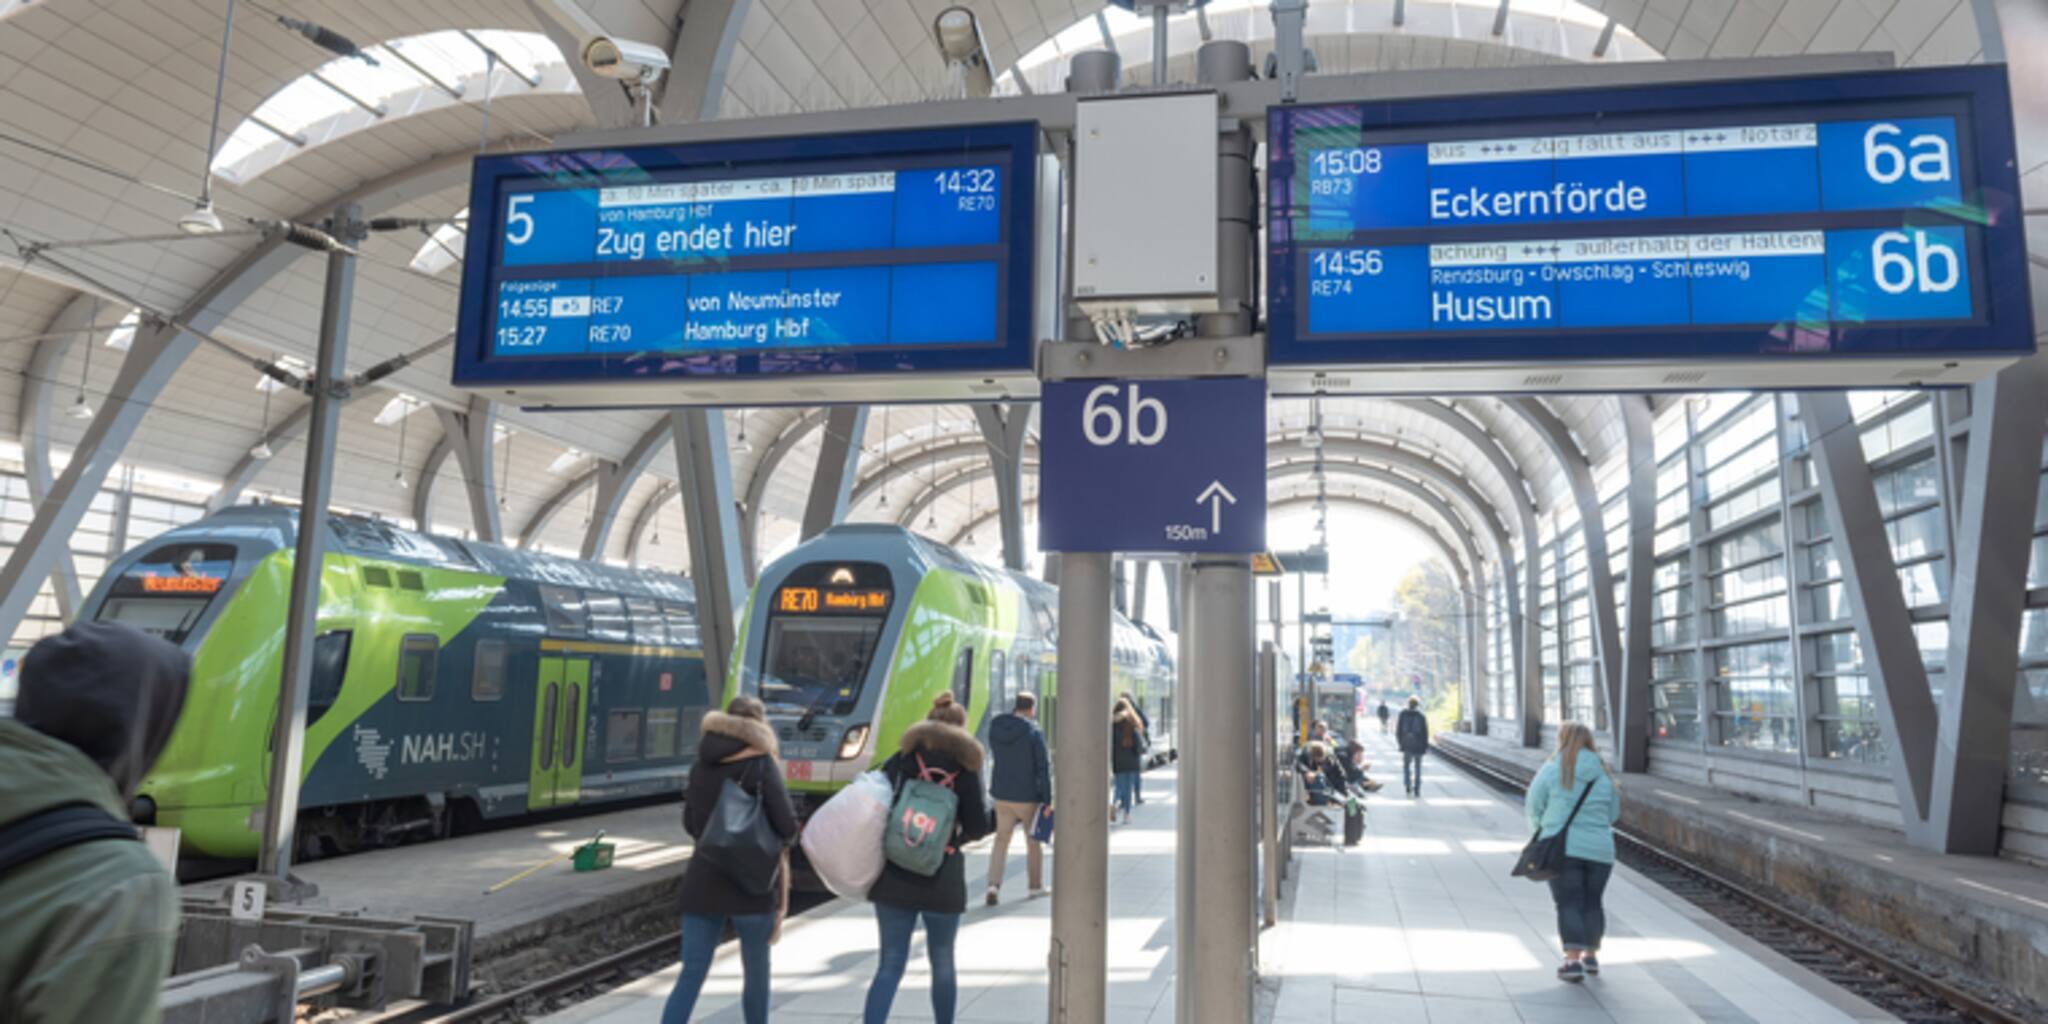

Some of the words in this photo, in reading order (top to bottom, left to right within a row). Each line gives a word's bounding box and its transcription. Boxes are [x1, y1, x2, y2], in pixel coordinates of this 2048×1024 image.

[1530, 138, 1570, 155] Zug
[1632, 133, 1671, 149] aus
[1864, 123, 1952, 184] 6a
[1314, 149, 1382, 175] 15:08
[935, 169, 995, 193] 14:32
[1312, 180, 1353, 195] RB73
[957, 196, 995, 211] RE70
[1430, 180, 1647, 219] Eckernförde
[506, 194, 534, 245] 5
[600, 209, 626, 222] von
[627, 206, 686, 222] Hamburg
[596, 228, 645, 261] Zug
[656, 222, 732, 252] endet
[744, 219, 797, 248] hier
[1696, 234, 1733, 252] der
[1314, 250, 1384, 275] 14:56
[1430, 268, 1524, 286] Rendsburg
[1540, 263, 1635, 283] Owschlag
[1651, 258, 1751, 279] Schleswig
[1871, 231, 1959, 294] 6b
[1312, 280, 1352, 296] RE74
[499, 298, 549, 318] 14:55
[592, 296, 623, 314] RE7
[687, 297, 721, 312] von
[727, 289, 841, 310] Neumünster
[1431, 290, 1552, 322] Husum
[497, 325, 548, 346] 15:27
[589, 325, 632, 343] RE70
[685, 321, 768, 343] Hamburg
[775, 317, 811, 338] Hbf
[1082, 384, 1169, 446] 6b
[1164, 524, 1208, 541] 150m
[781, 587, 818, 612] RE70
[401, 731, 487, 764] NAH.SH
[242, 886, 255, 912] 5
